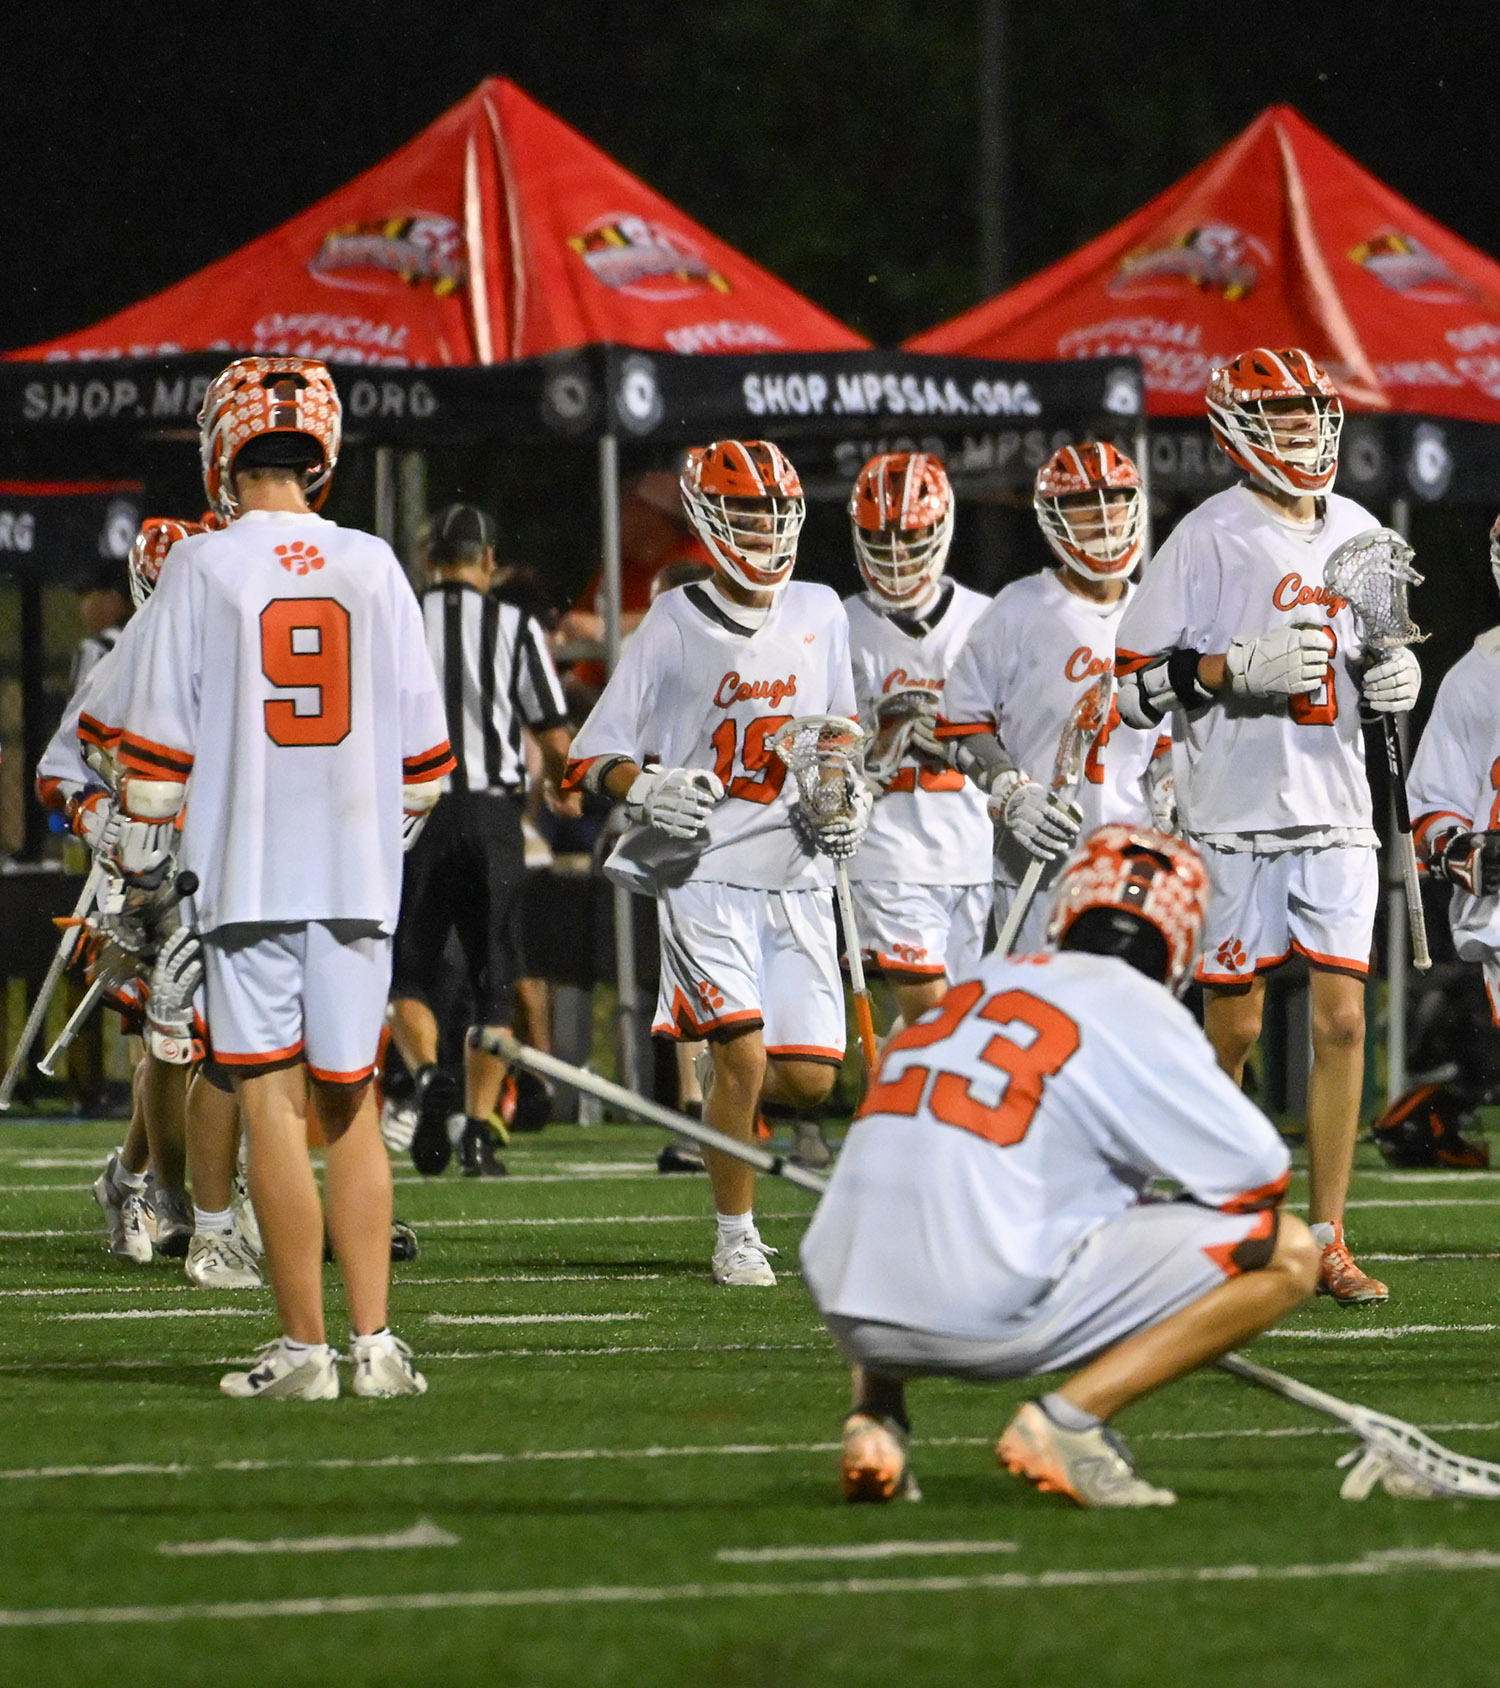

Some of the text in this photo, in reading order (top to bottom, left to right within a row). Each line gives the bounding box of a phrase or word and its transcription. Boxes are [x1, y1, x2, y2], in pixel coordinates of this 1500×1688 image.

[742, 373, 1043, 417] SHOP.MPSSAA.ORG
[259, 596, 352, 748] 9
[713, 671, 797, 709] Cougs
[856, 979, 1081, 1149] 23
